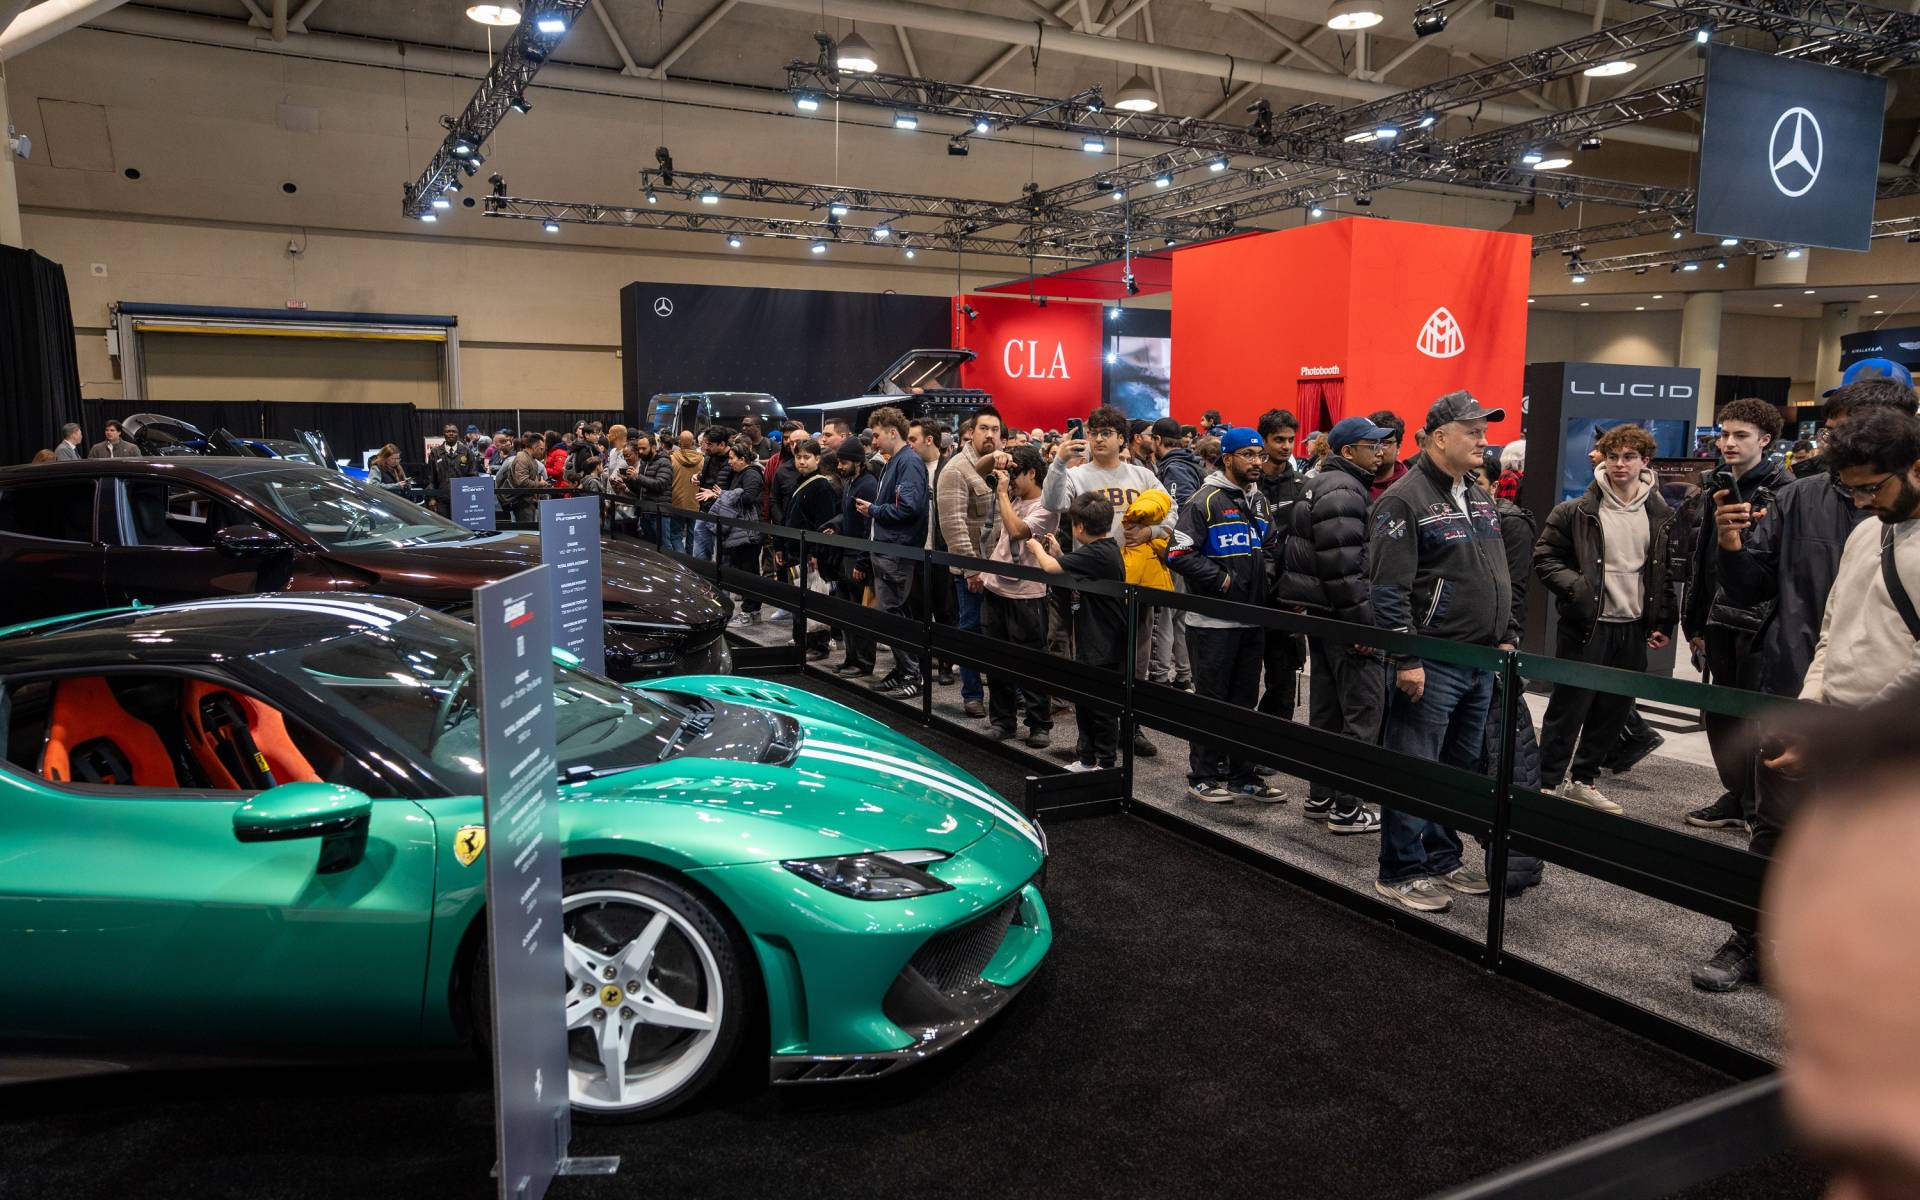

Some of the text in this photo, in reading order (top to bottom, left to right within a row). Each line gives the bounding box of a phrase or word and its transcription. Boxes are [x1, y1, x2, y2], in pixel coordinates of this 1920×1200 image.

[1003, 338, 1071, 379] CLA
[1300, 364, 1340, 376] Photobooth
[1570, 380, 1693, 398] LUCID
